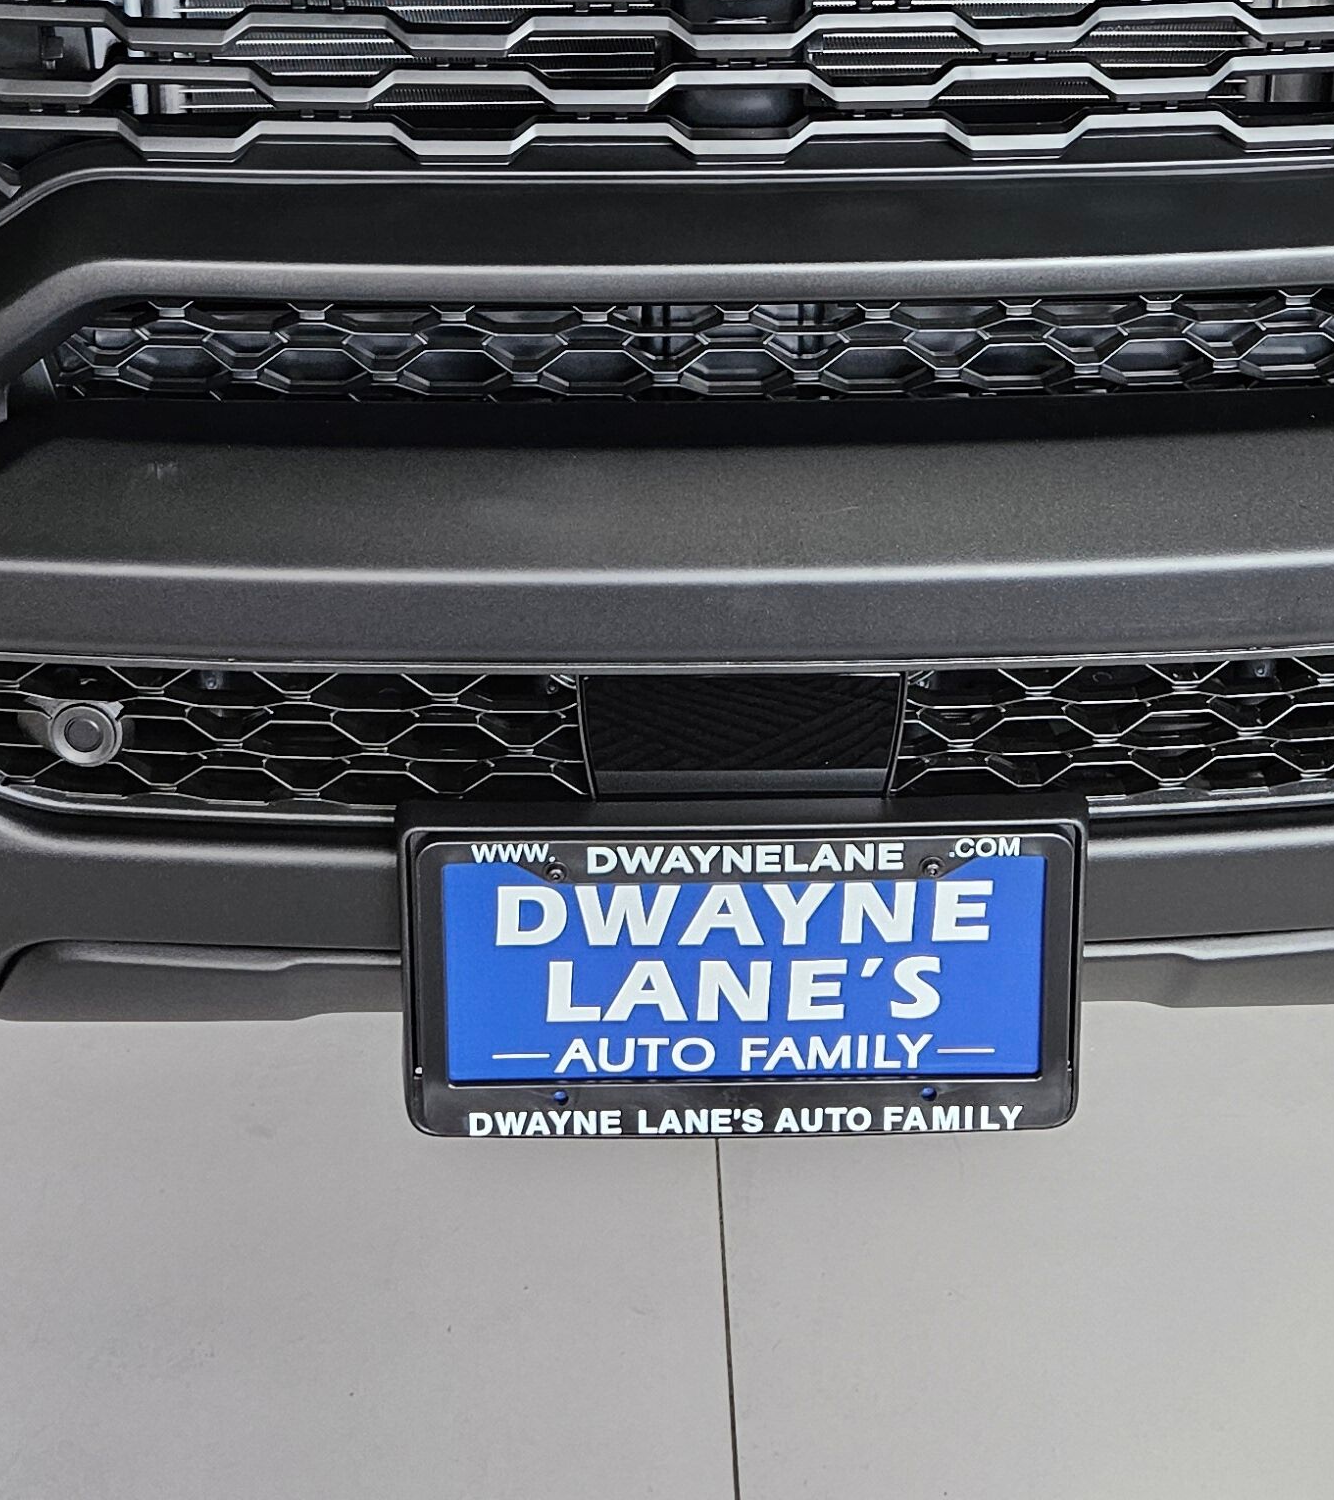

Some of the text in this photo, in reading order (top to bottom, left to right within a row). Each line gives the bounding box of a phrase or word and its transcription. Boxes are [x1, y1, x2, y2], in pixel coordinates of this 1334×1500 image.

[586, 843, 905, 875] DWAYNELANE
[494, 880, 994, 947] DWAYNE
[545, 955, 942, 1023] LANE'S
[553, 1033, 934, 1073] AUTO FAMILY
[468, 1105, 1023, 1136] DWAYNE LANE'S AUTO FAMILY
